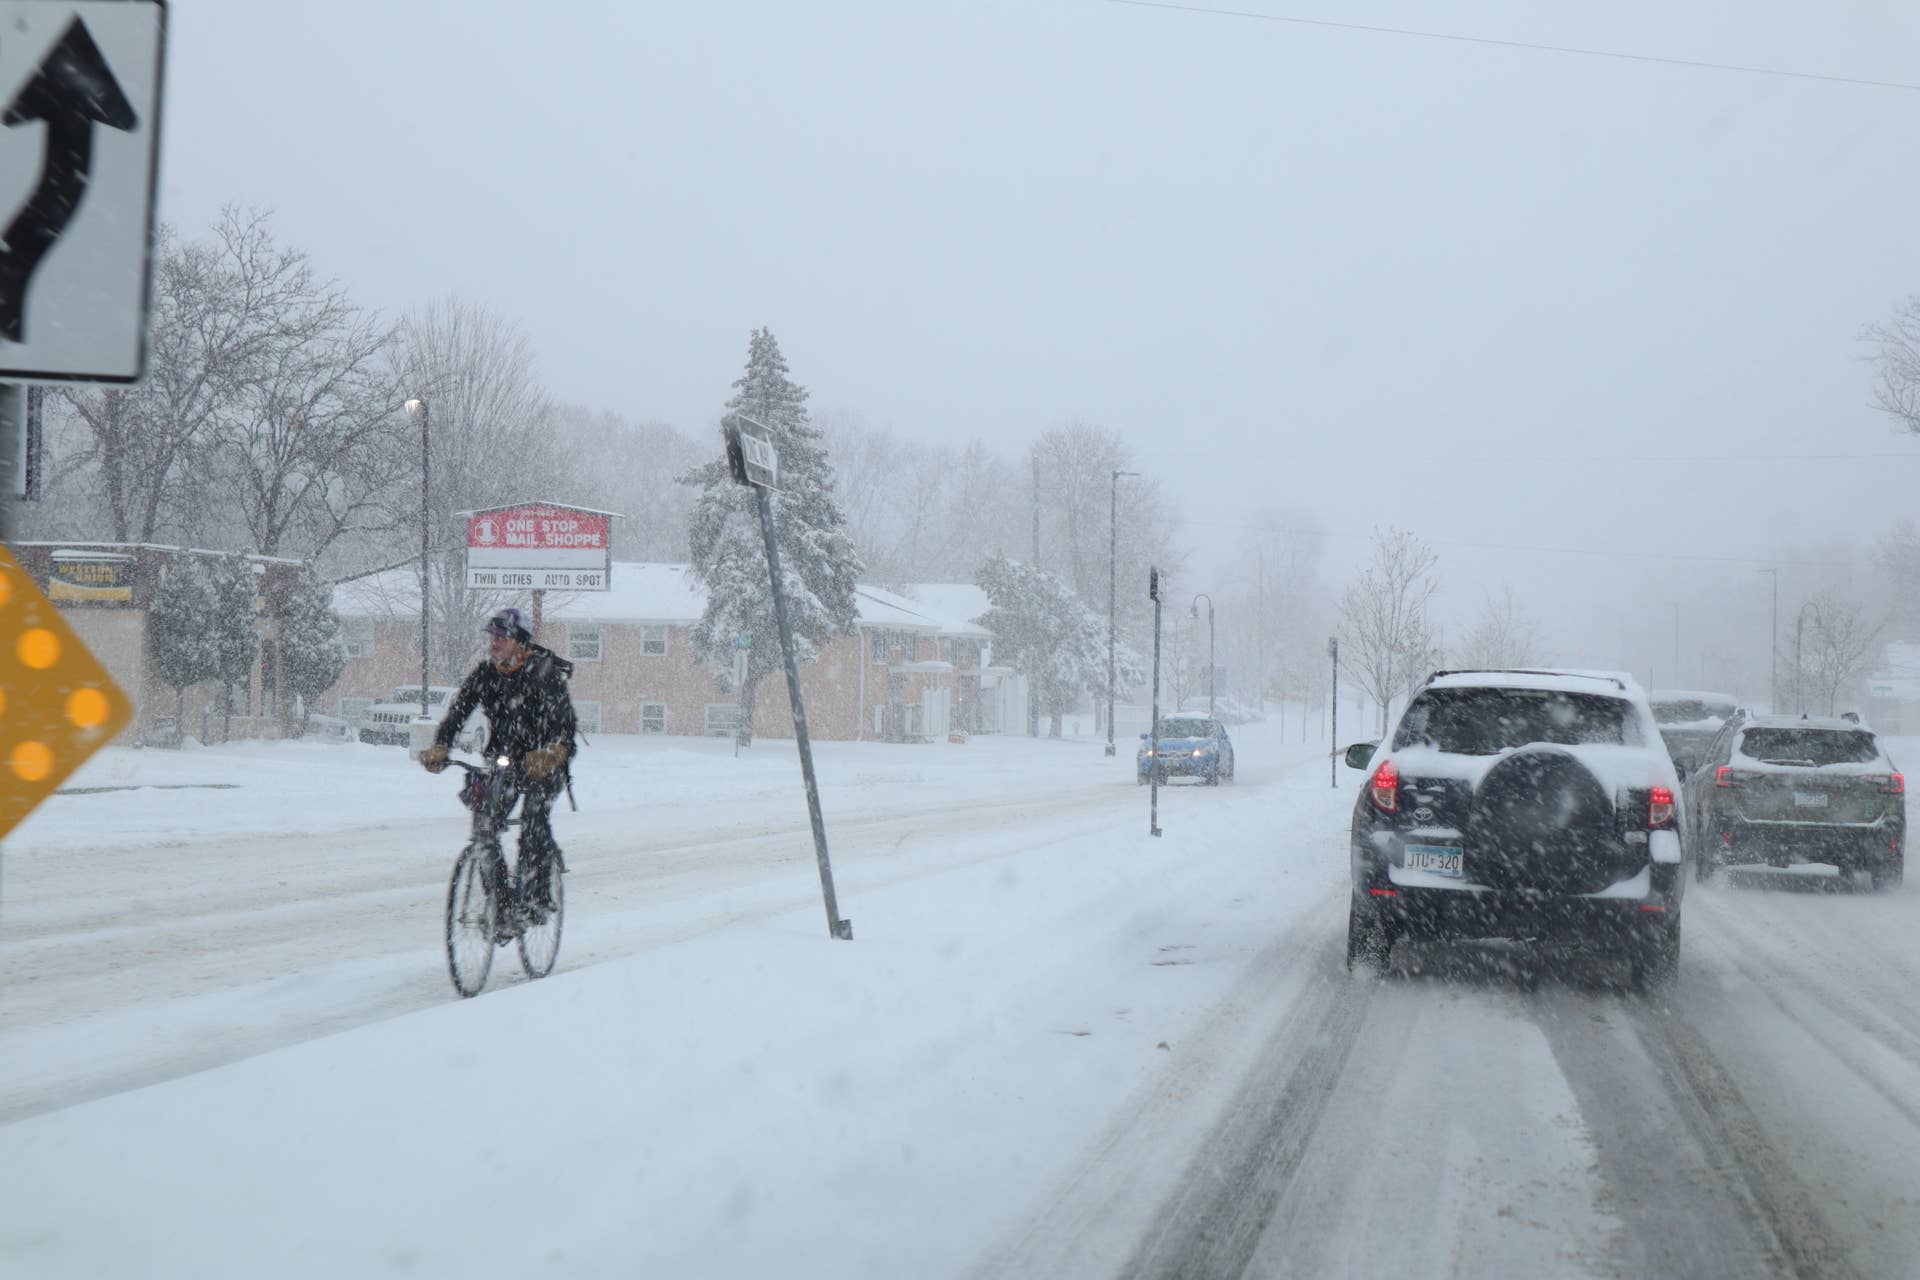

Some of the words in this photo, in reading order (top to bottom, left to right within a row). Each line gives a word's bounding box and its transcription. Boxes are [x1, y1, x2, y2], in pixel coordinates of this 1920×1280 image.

[478, 520, 495, 542] 1
[506, 520, 535, 532] ONE
[542, 520, 578, 532] STOP
[506, 533, 539, 545] MAIL
[545, 533, 601, 545] SHOPPE
[474, 573, 497, 585] TWIN
[502, 573, 533, 585] CITIES
[545, 574, 570, 585] AUTO
[576, 574, 601, 586] SPOT
[1438, 855, 1459, 870] 320
